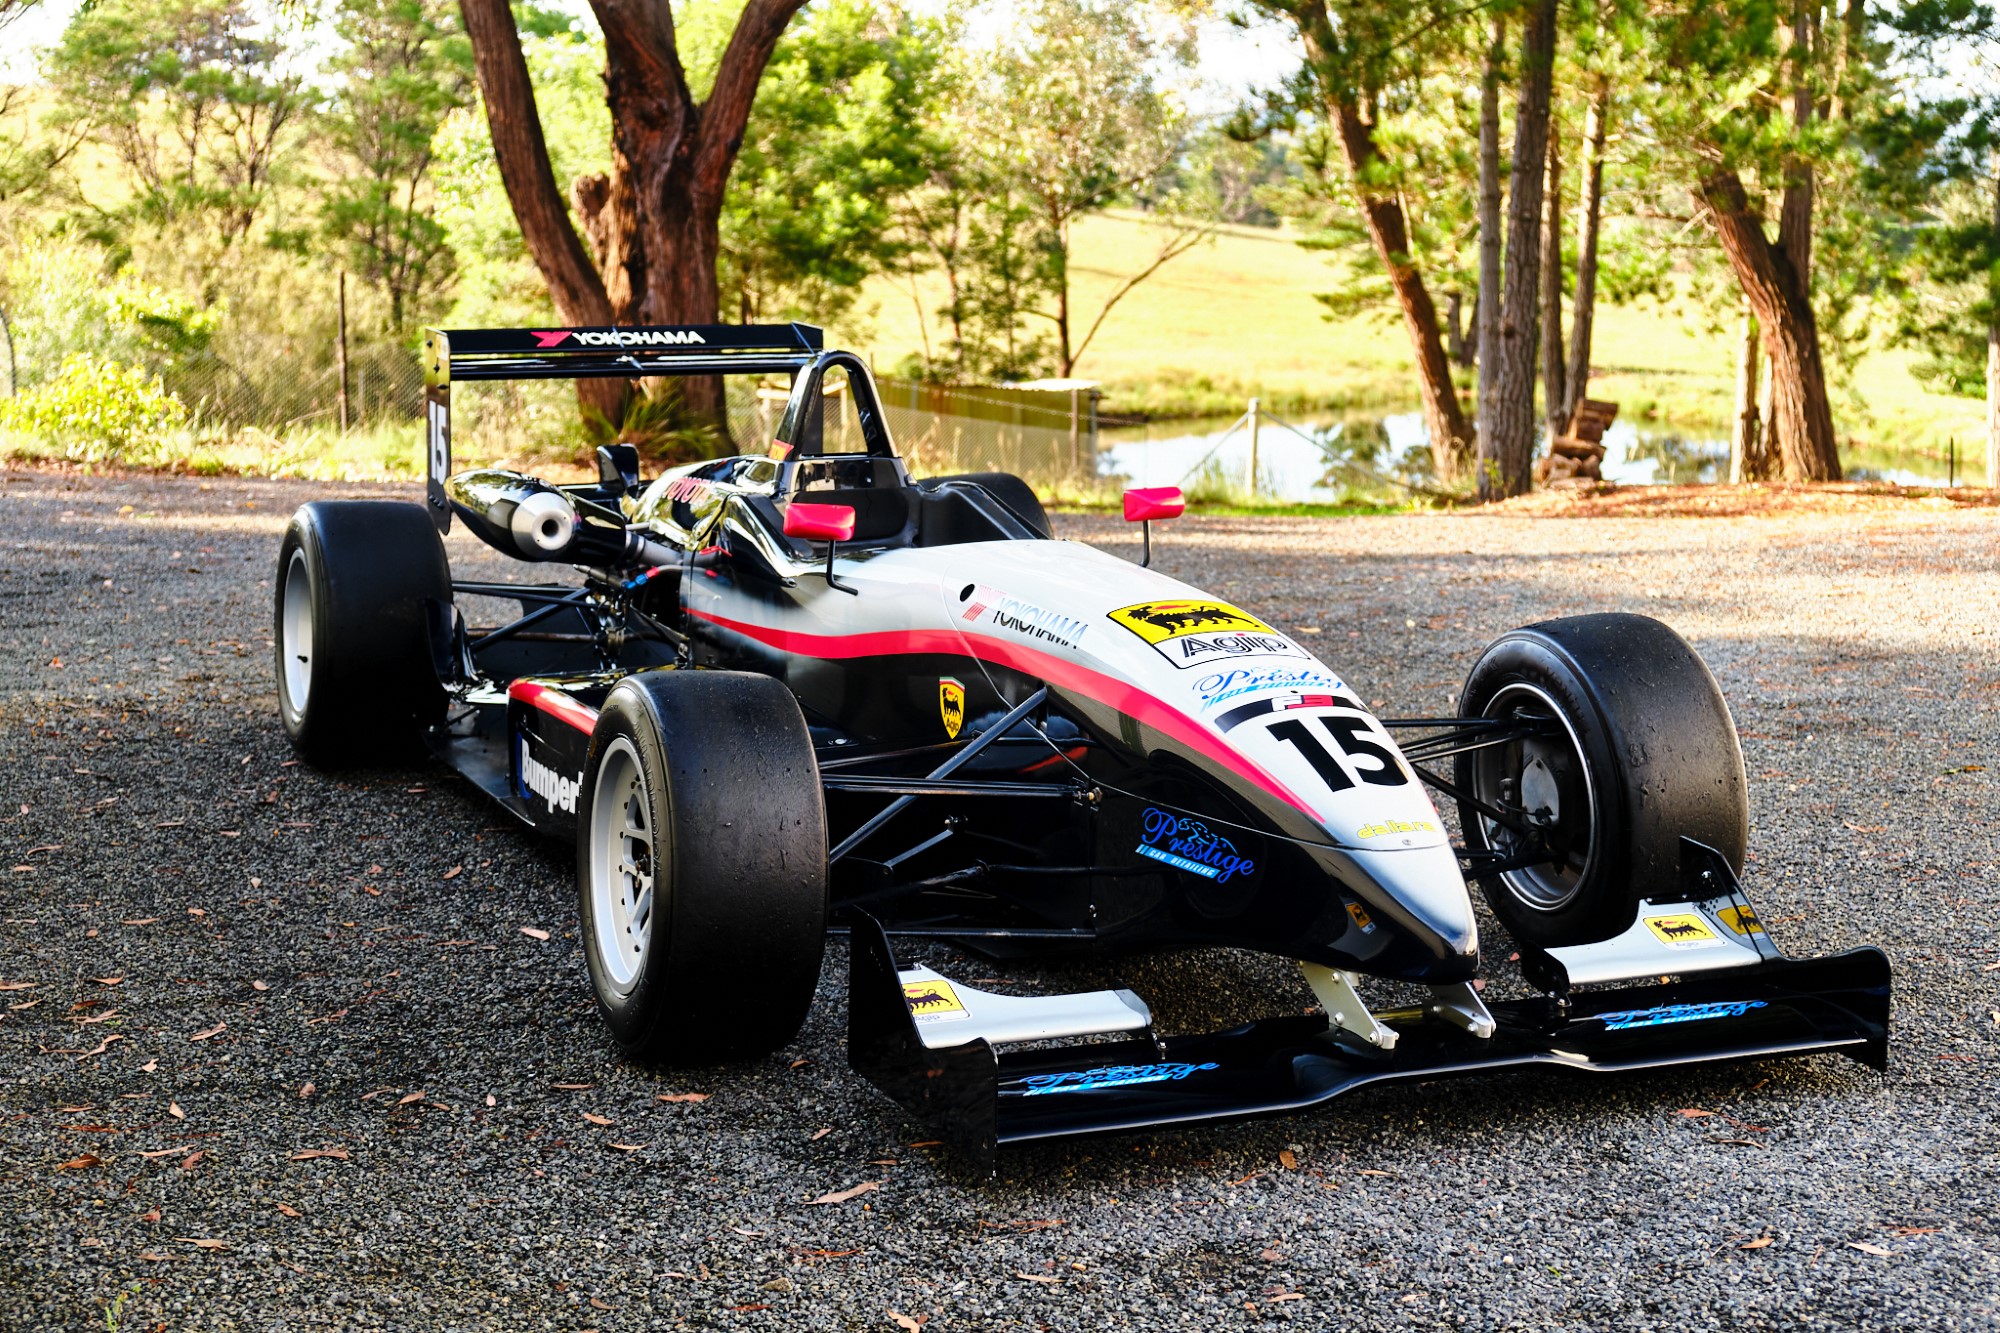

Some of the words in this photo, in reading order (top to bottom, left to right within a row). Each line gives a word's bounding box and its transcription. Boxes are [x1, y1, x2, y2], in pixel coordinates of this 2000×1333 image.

[571, 330, 706, 346] YOKOHAMA
[428, 400, 447, 486] 15
[992, 597, 1089, 650] YOKOHAMA
[1180, 633, 1288, 659] Agip
[1192, 669, 1343, 700] Prestig
[1270, 694, 1334, 712] F3
[1265, 715, 1409, 793] 15
[1357, 819, 1437, 840] dallara
[1141, 806, 1255, 884] Prestige
[1149, 849, 1167, 860] CAR
[1170, 857, 1215, 876] DETAILING
[1596, 1000, 1769, 1025] Prestige
[1018, 1062, 1220, 1090] Prestige
